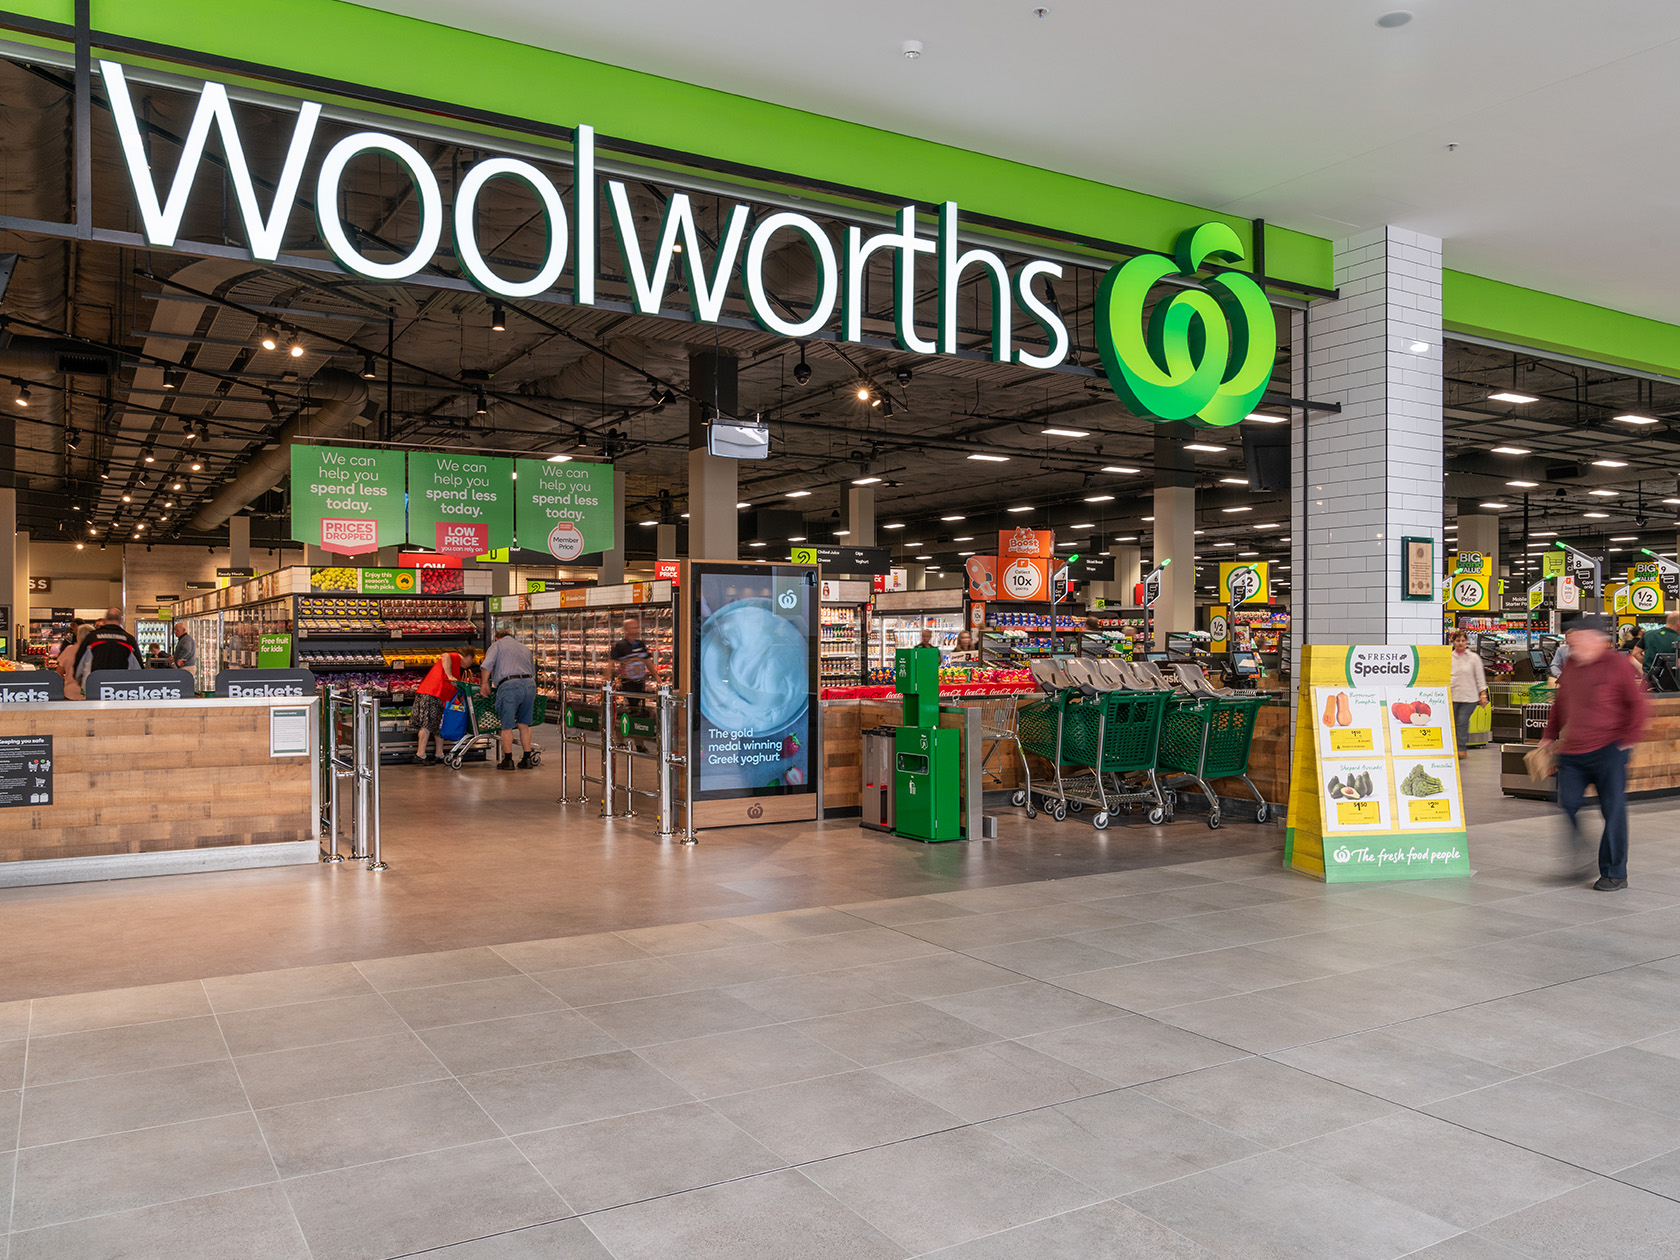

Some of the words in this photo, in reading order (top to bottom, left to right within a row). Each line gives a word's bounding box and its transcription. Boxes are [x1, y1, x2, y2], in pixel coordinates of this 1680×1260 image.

[99, 60, 1069, 369] Woolworths
[321, 452, 346, 465] We
[350, 457, 376, 466] can
[436, 458, 459, 471] We
[462, 464, 487, 473] can
[319, 466, 350, 481] help
[354, 472, 379, 483] you
[542, 466, 563, 477] We
[566, 469, 589, 478] can
[434, 472, 462, 487] help
[466, 478, 489, 488] you
[540, 479, 566, 492] help
[569, 483, 591, 494] you
[310, 483, 355, 496] spend
[360, 484, 388, 496] less
[426, 489, 467, 501] spend
[472, 489, 497, 501] less
[326, 498, 372, 513] today.
[532, 494, 570, 506] spend
[575, 495, 598, 506] less
[440, 503, 483, 518] today.
[546, 508, 585, 521] today.
[326, 522, 373, 533] PRICES
[448, 527, 475, 536] LOW
[326, 532, 373, 541] DROPPED
[444, 536, 479, 546] PRICE
[1009, 539, 1039, 548] Boost
[1460, 552, 1481, 562] BIG
[1637, 564, 1656, 573] BIG
[1013, 576, 1032, 586] 10x
[1460, 584, 1477, 597] 1/2
[1638, 592, 1652, 602] 1/2
[1214, 622, 1223, 632] 1/2
[1354, 662, 1410, 677] Specials
[0, 688, 49, 702] kets
[100, 686, 181, 700] Baskets
[229, 684, 303, 698] Baskets
[708, 728, 728, 738] The
[731, 728, 753, 740] gold
[708, 742, 741, 752] medal
[743, 740, 782, 751] winning
[708, 753, 739, 764] Greek
[740, 752, 780, 766] yoghurt
[1350, 847, 1376, 862] The
[1378, 848, 1405, 867] fresh
[1406, 846, 1429, 865] food
[1431, 847, 1461, 864] people
